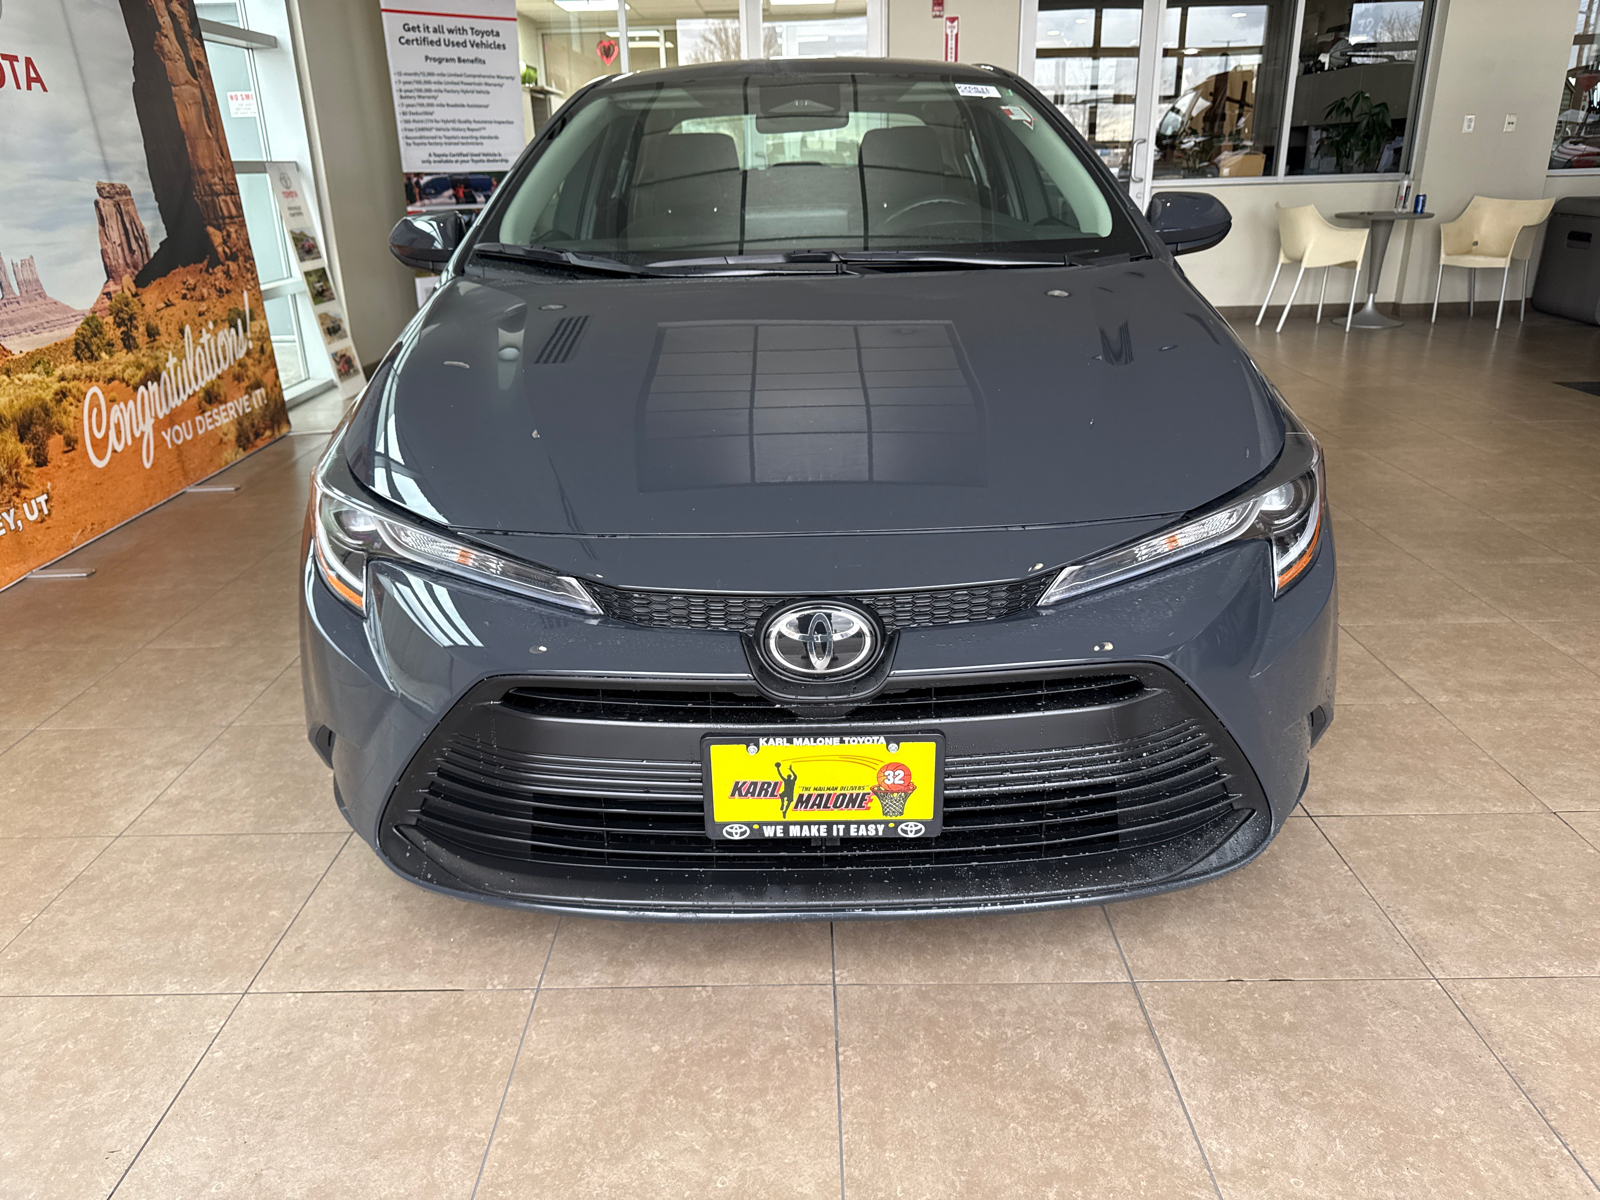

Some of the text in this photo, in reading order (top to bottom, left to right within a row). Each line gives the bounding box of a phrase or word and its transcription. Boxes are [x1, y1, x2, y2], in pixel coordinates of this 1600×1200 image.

[402, 22, 501, 39] Get it all with Toyota
[398, 35, 507, 51] Certified Used Vehicles
[424, 55, 486, 65] Program Benefits
[0, 53, 49, 93] TA
[83, 289, 254, 470] Congratulations!
[161, 387, 268, 449] YOU DESERVE IT!
[22, 493, 50, 522] UT
[759, 735, 886, 747] KARL MALONE TOYOTA
[883, 769, 905, 785] 32
[729, 780, 783, 799] KARL
[793, 792, 872, 811] MALONE
[762, 824, 885, 837] WE MAKE IT EASY
